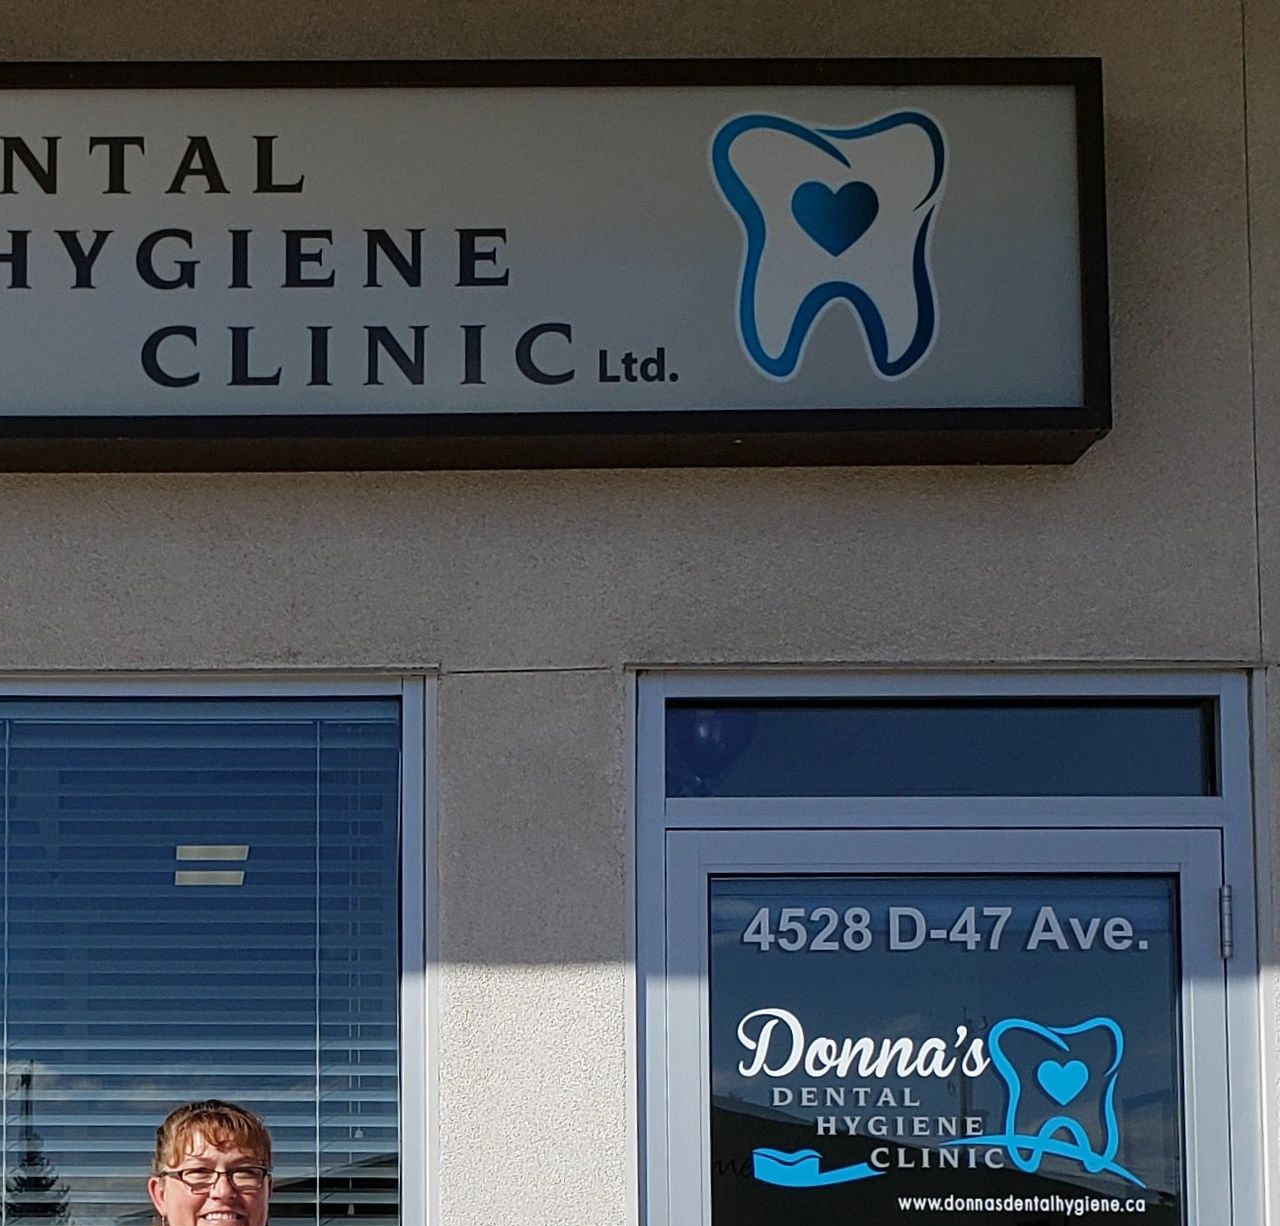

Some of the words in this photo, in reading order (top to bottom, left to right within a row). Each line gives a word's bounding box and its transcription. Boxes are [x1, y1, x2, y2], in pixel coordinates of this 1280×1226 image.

[140, 322, 576, 388] CLINIC
[598, 347, 680, 383] Ltd.
[743, 906, 872, 951] 4528
[889, 906, 1013, 950] D-47
[1026, 906, 1149, 950] Ave.
[737, 1008, 990, 1078] Donna's
[772, 1087, 920, 1107] DENTAL
[816, 1116, 984, 1137] HYGIENE
[870, 1148, 1005, 1169] CLINIC
[897, 1194, 1146, 1216] www.donnasdentalhygiene.ca
